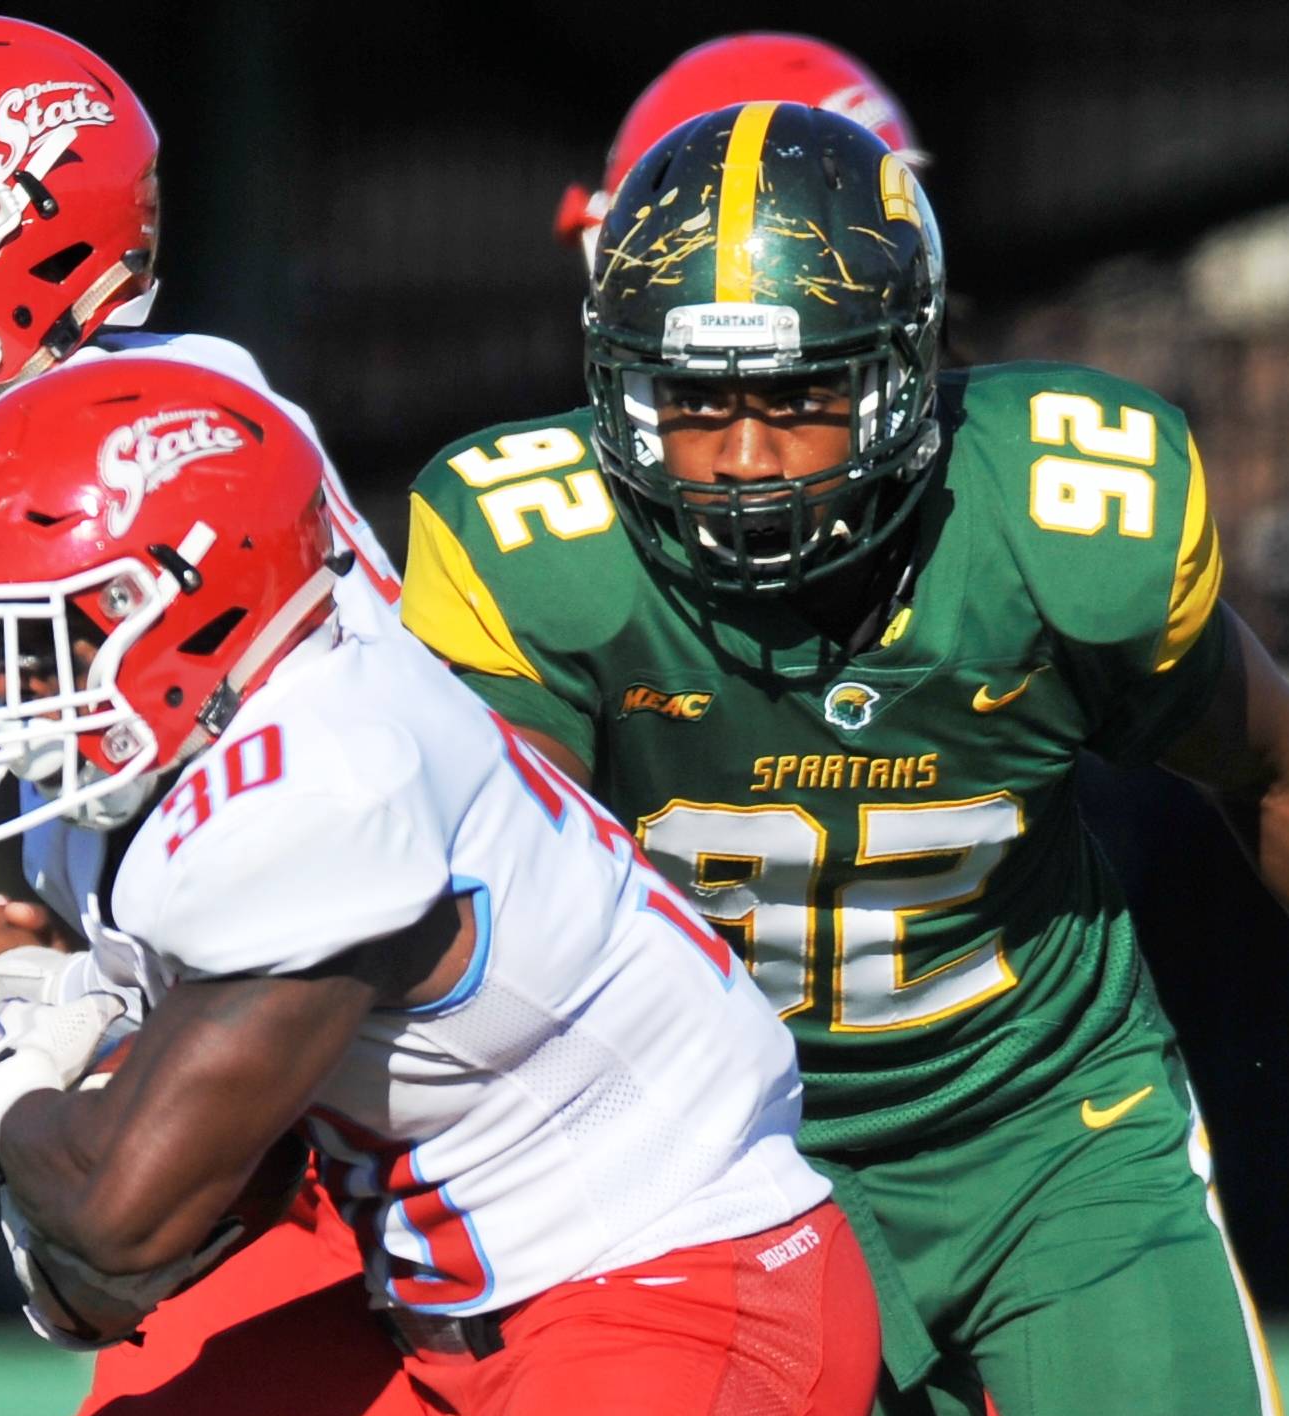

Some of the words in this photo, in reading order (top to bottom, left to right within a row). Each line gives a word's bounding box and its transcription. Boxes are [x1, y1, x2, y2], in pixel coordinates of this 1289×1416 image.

[699, 314, 766, 327] SPARTANS
[100, 425, 244, 540] State
[447, 427, 616, 554] 92
[1029, 391, 1157, 539] 92
[622, 687, 712, 719] MEAC
[160, 722, 284, 862] 30
[749, 752, 939, 793] SPARTANS
[635, 790, 1026, 1033] 92
[755, 1224, 822, 1273] HORNETS
